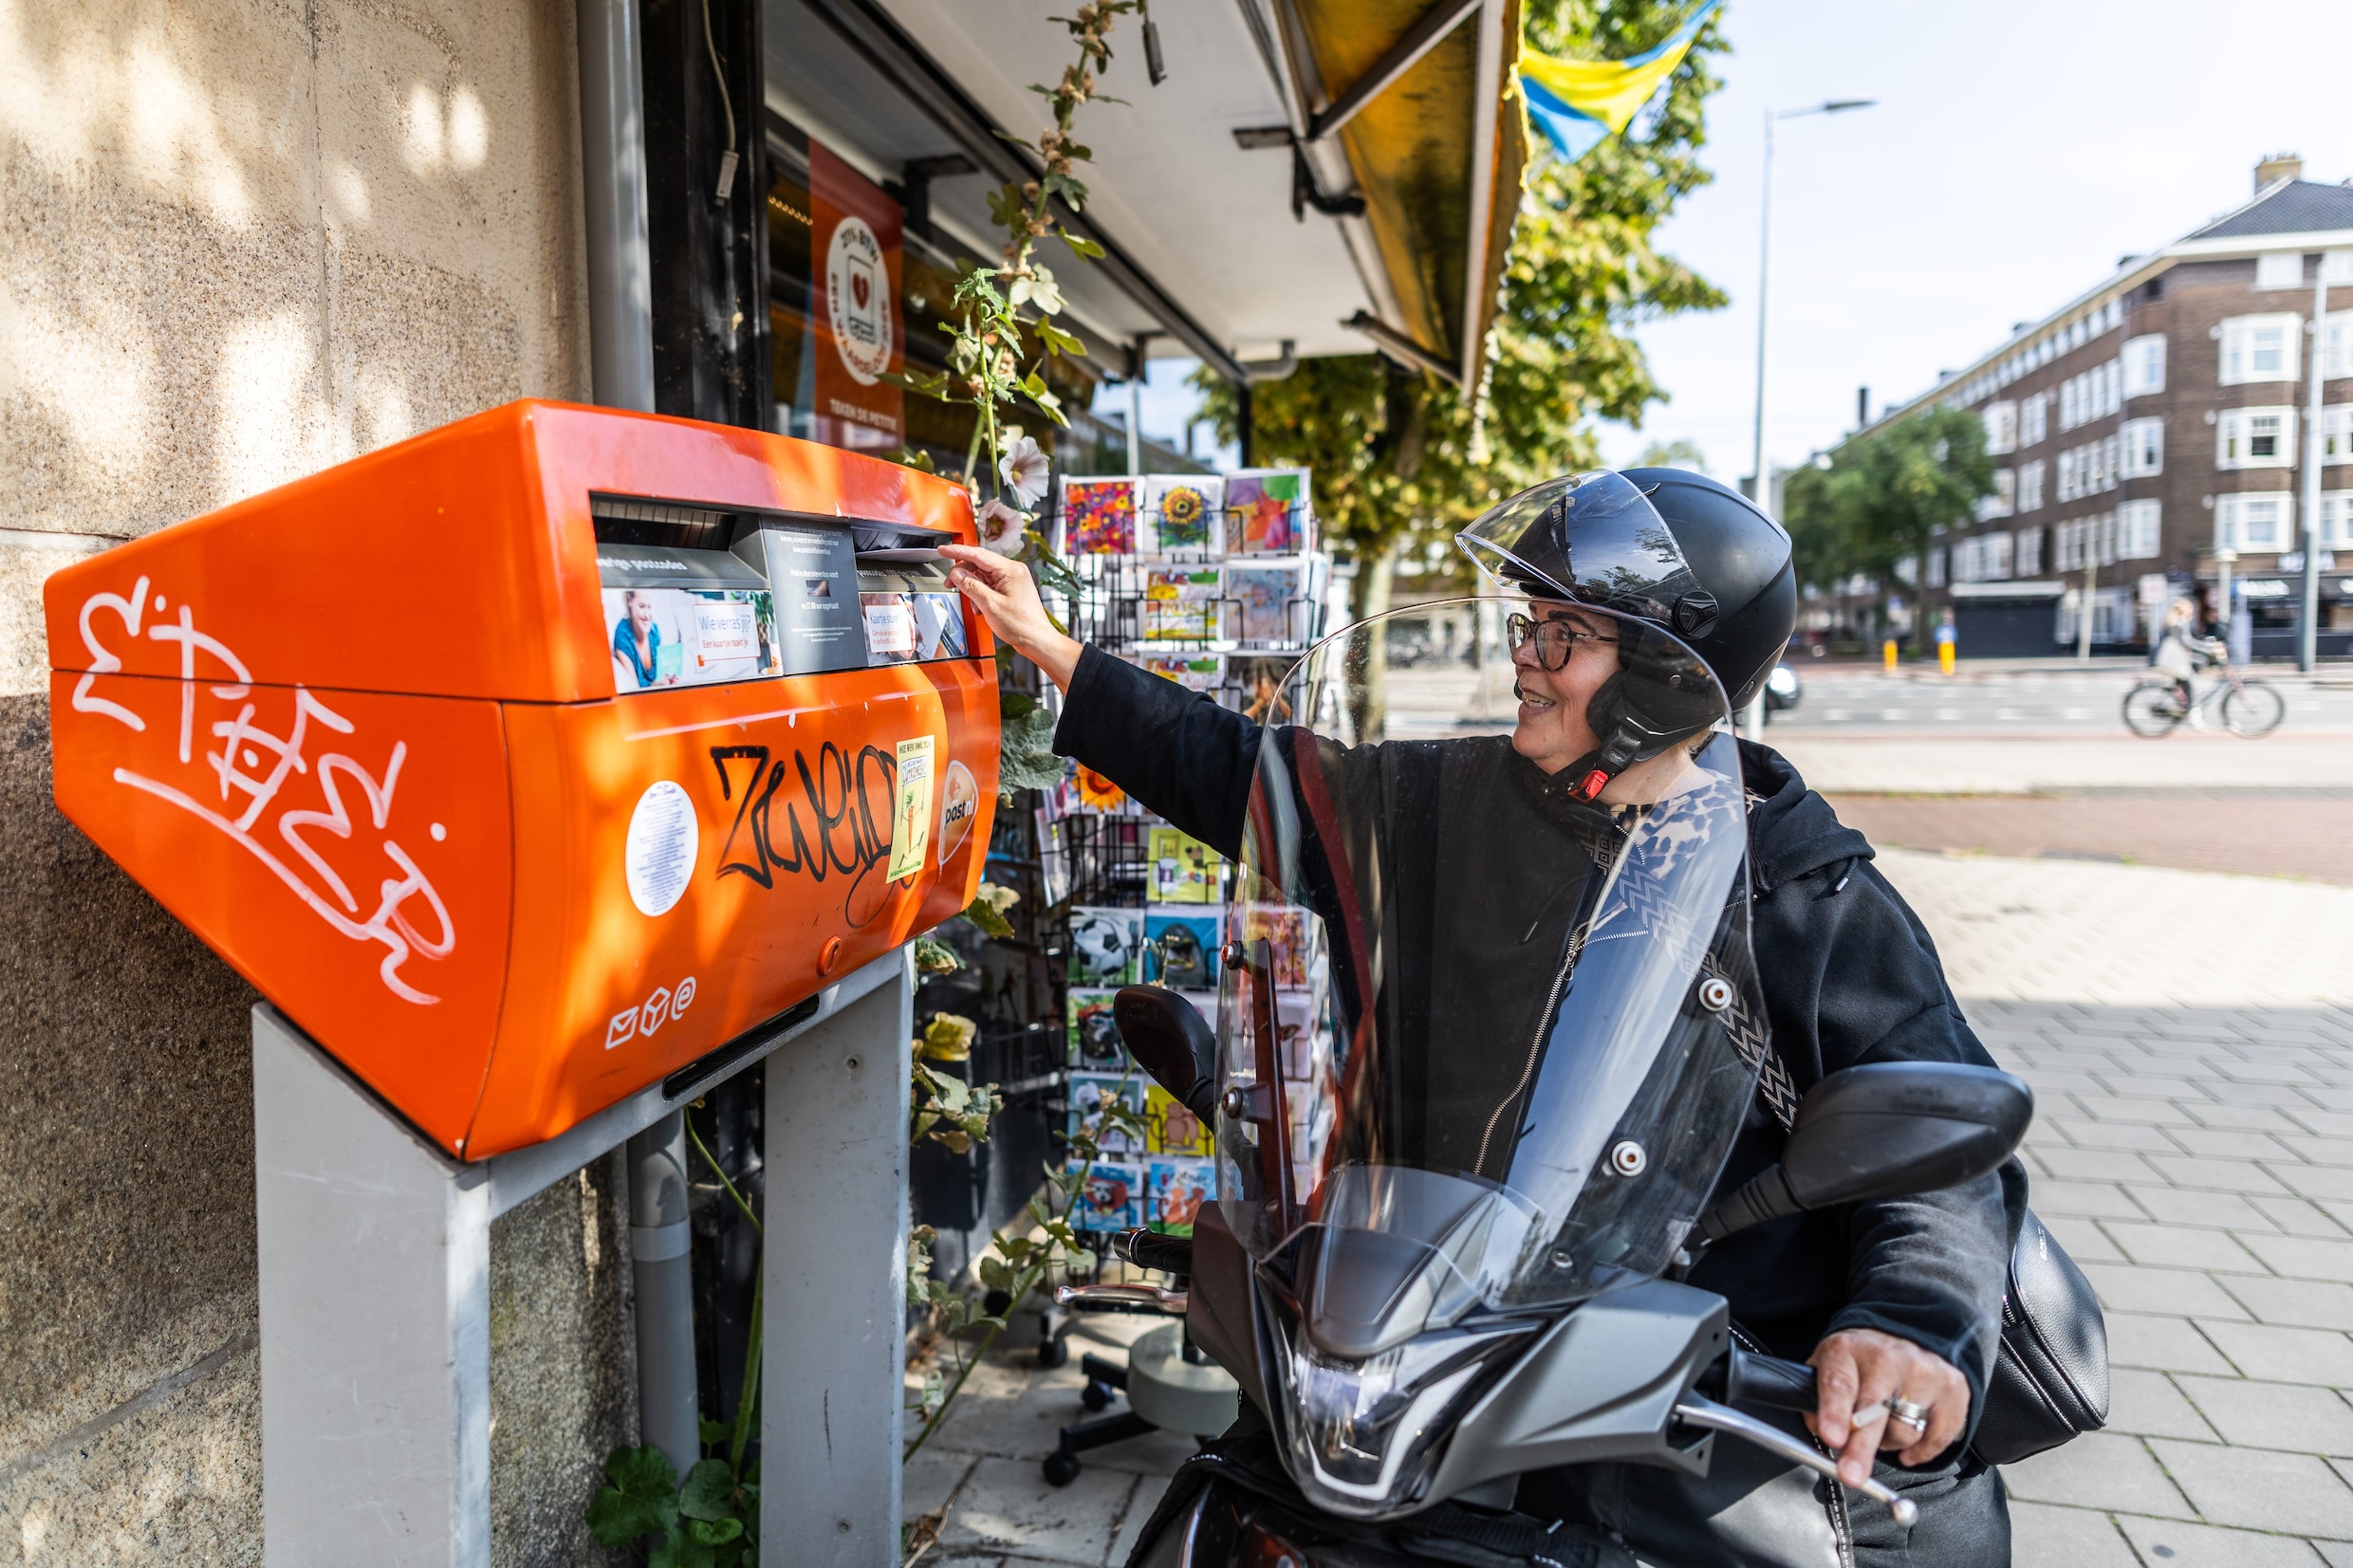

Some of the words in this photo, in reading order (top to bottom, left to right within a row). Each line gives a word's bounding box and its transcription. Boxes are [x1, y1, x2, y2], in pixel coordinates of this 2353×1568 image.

[830, 271, 839, 314] EEN
[830, 398, 856, 418] TEKEN
[857, 407, 867, 423] DE
[869, 411, 897, 432] PETITIE
[596, 557, 633, 571] verige
[630, 558, 688, 571] postcodes
[699, 616, 715, 630] Wie
[716, 618, 741, 630] verras
[702, 639, 712, 648] Een
